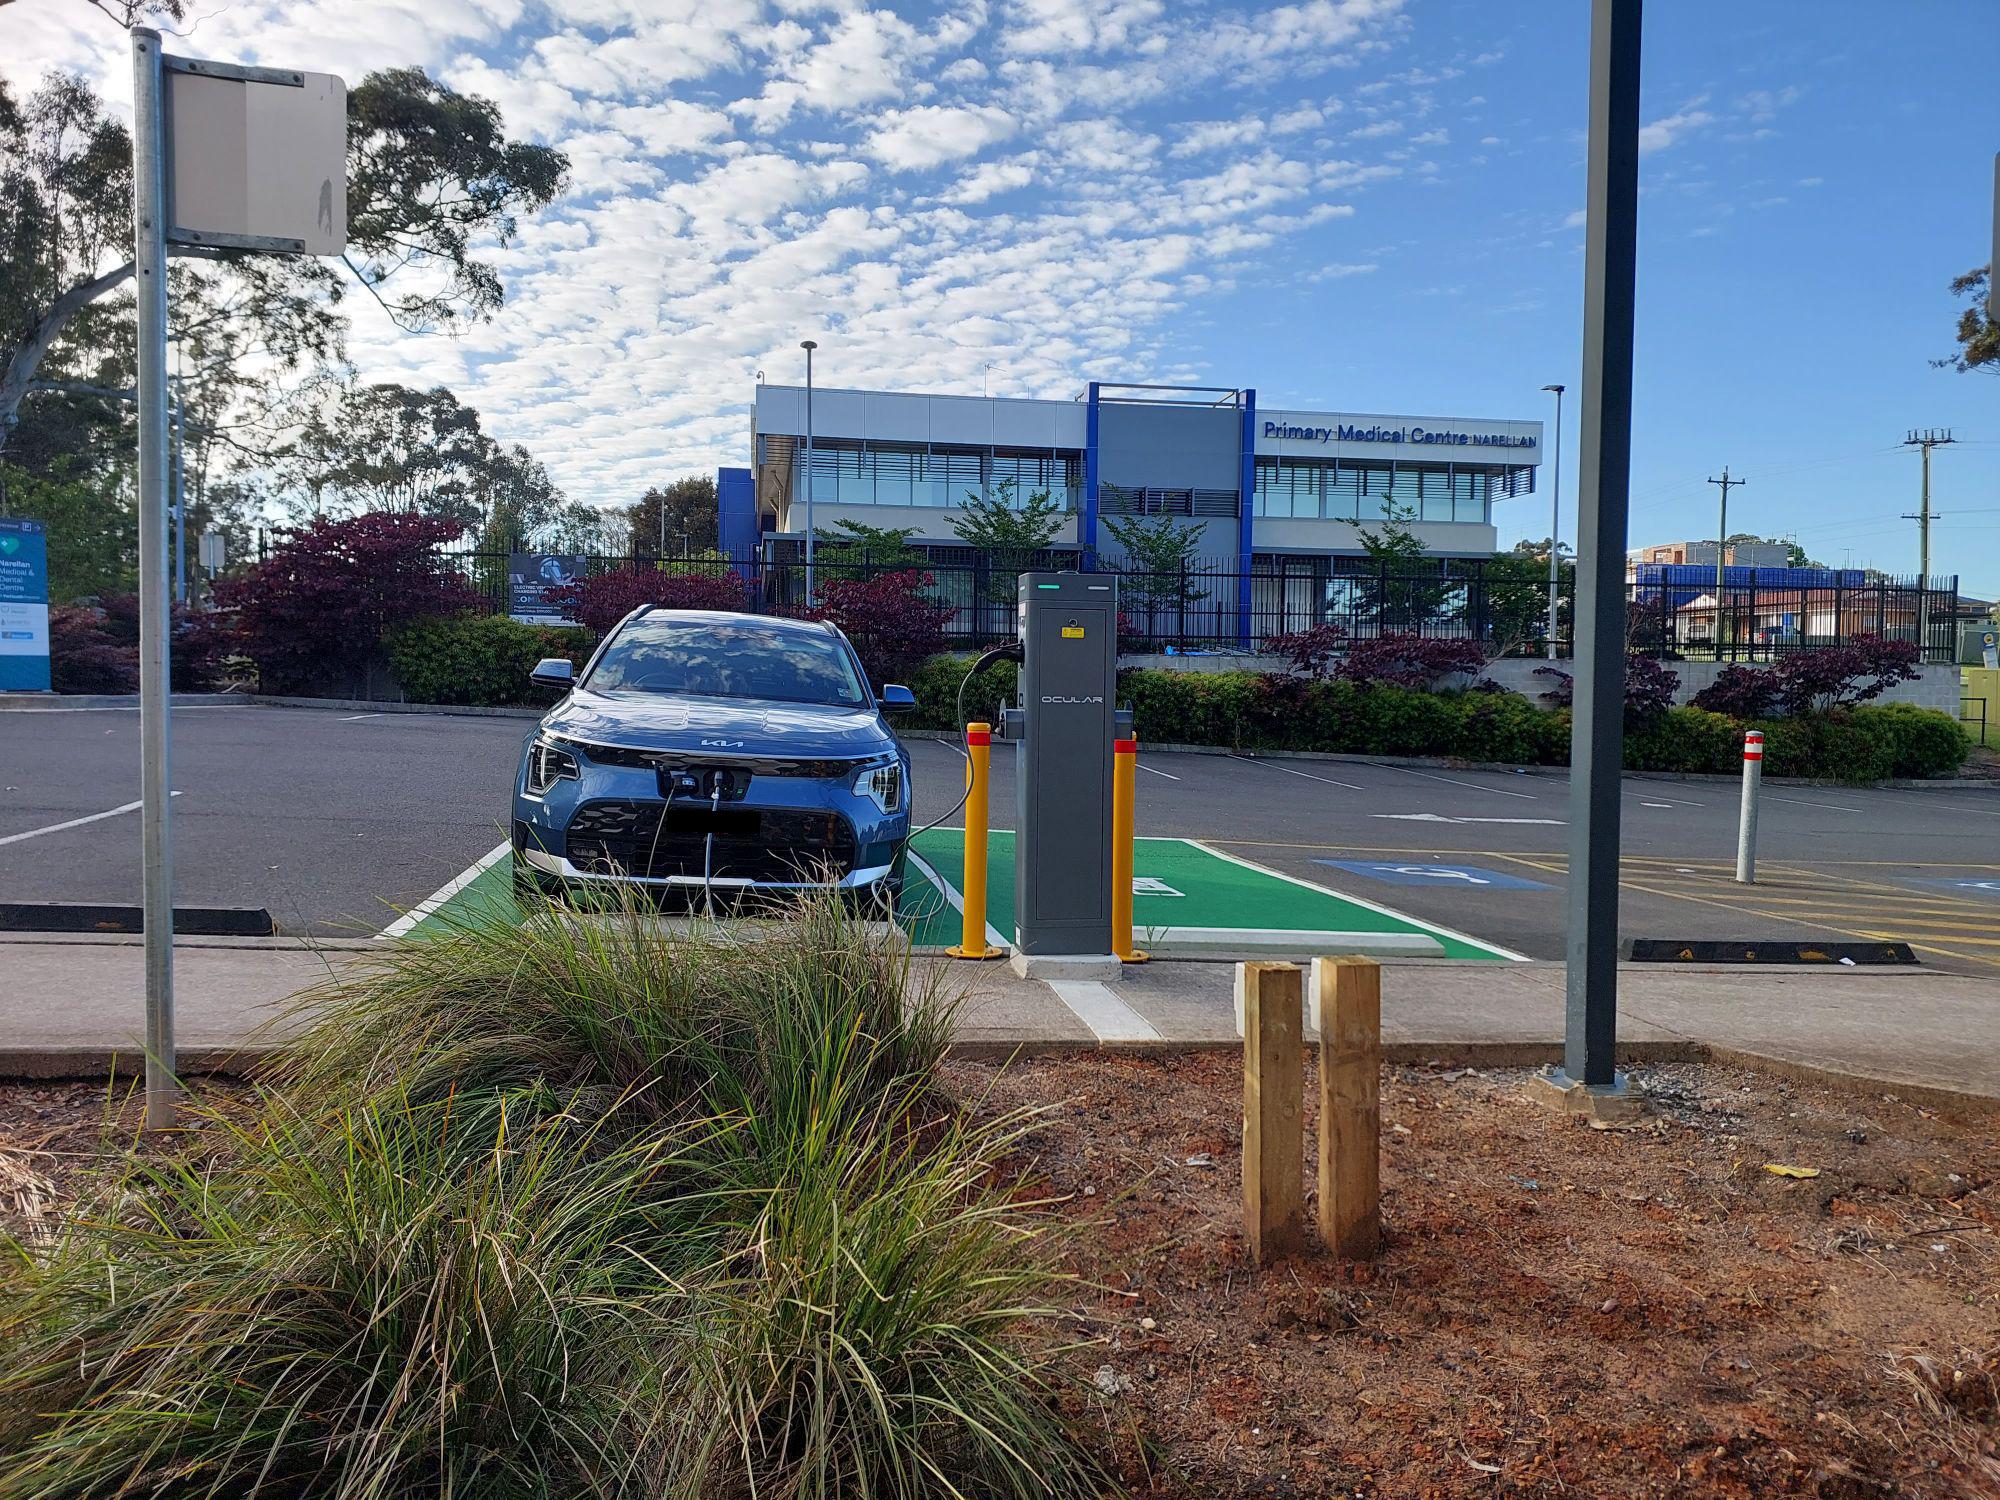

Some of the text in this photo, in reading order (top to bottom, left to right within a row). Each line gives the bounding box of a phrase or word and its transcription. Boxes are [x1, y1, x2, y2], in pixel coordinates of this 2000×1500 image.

[1264, 421, 1536, 448] Primary Medical Centre NARELLAN
[0, 560, 31, 568] Narellan
[0, 568, 27, 577] Medical
